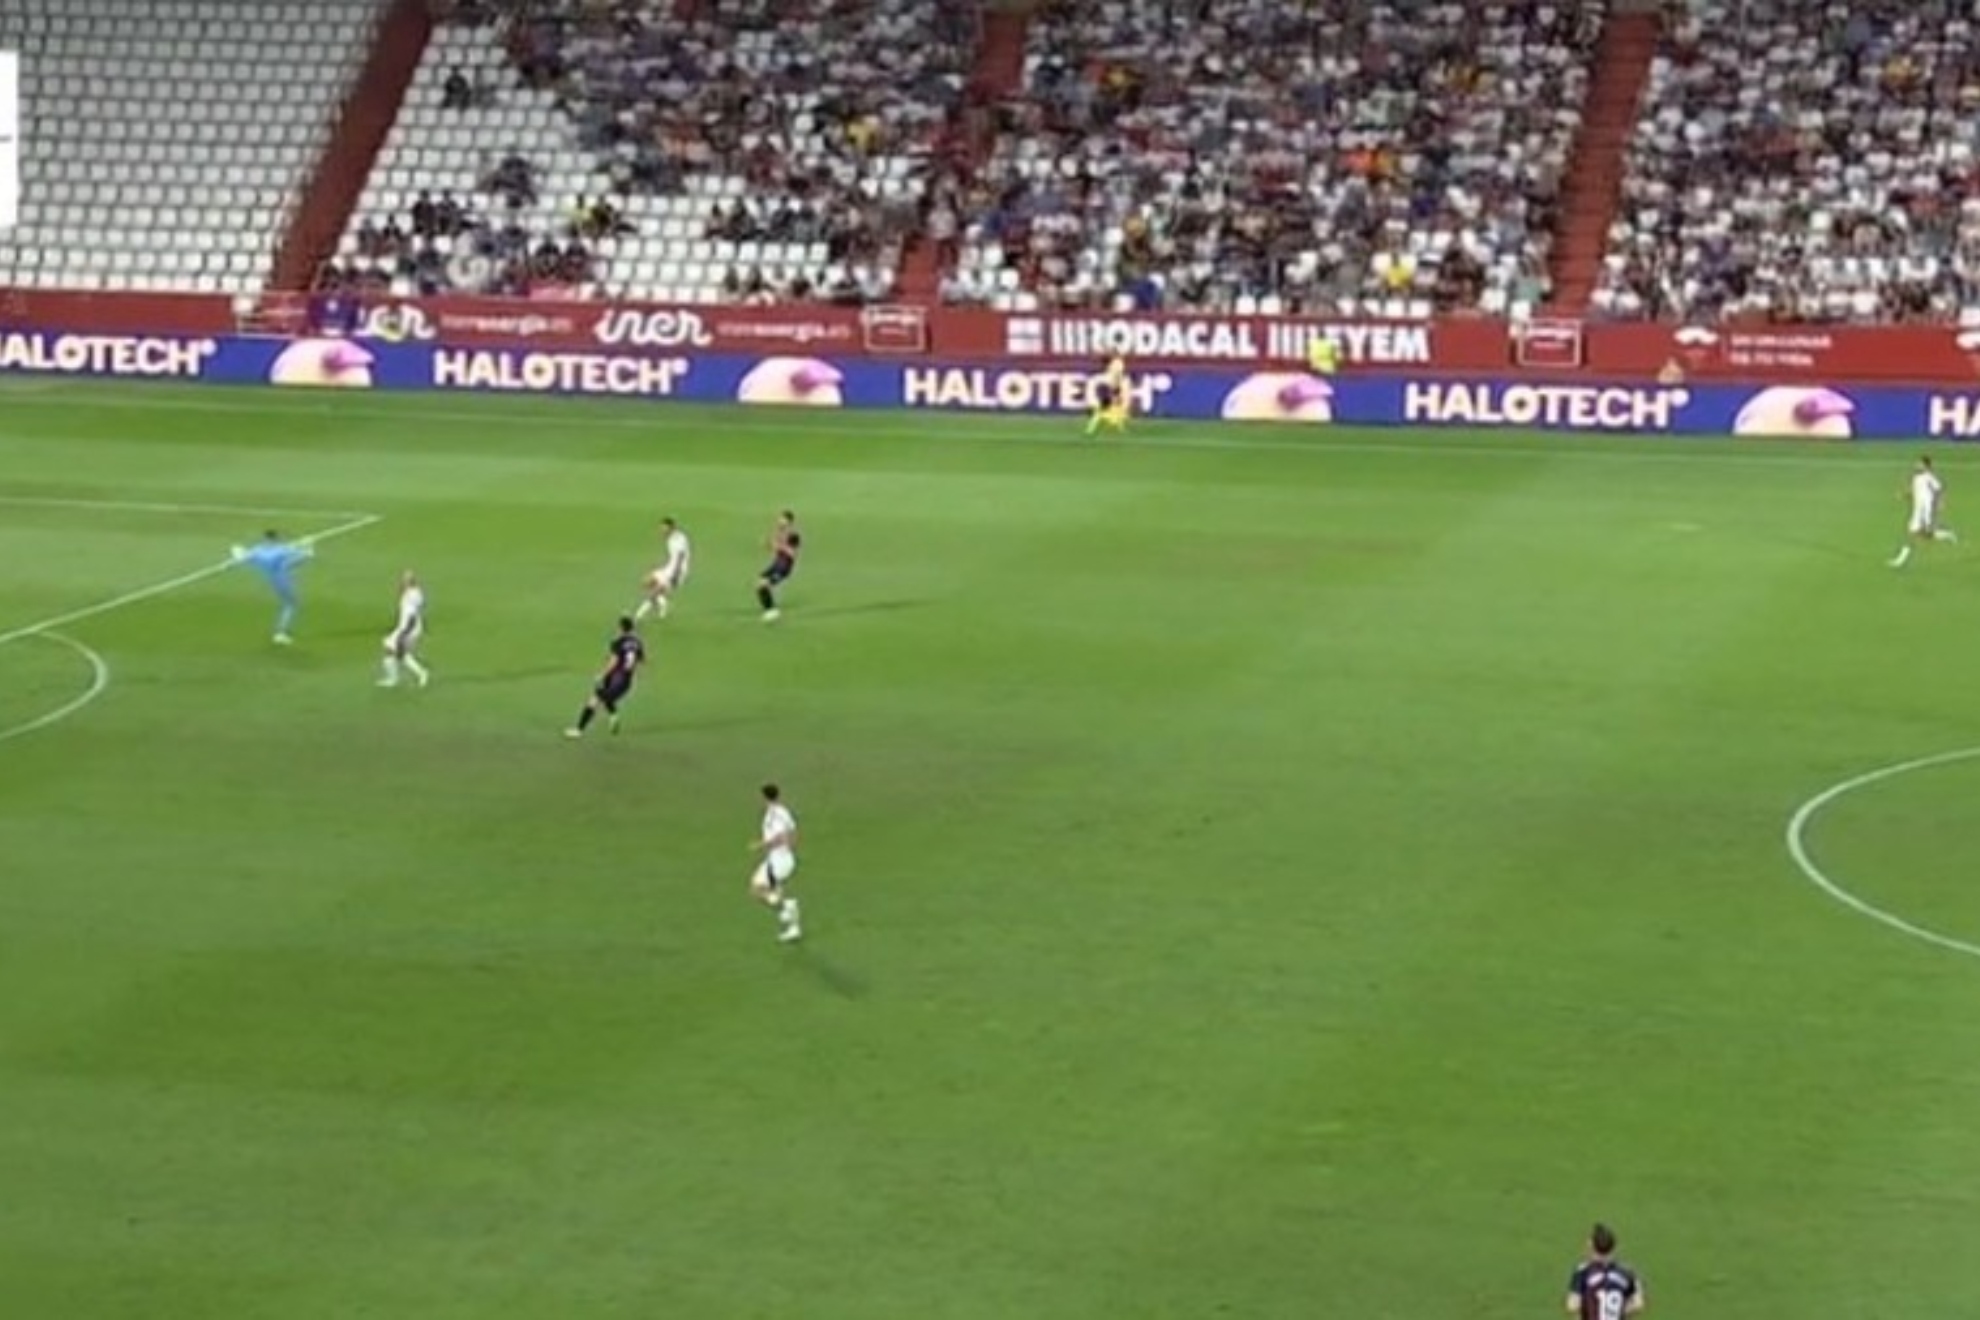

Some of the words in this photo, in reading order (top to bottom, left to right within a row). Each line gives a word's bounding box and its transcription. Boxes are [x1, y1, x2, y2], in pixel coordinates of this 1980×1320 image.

[0, 332, 201, 376] ALOTECH
[432, 349, 673, 394] HALOTECH
[1403, 382, 1668, 428] HALOTECH
[1929, 395, 1980, 436] H
